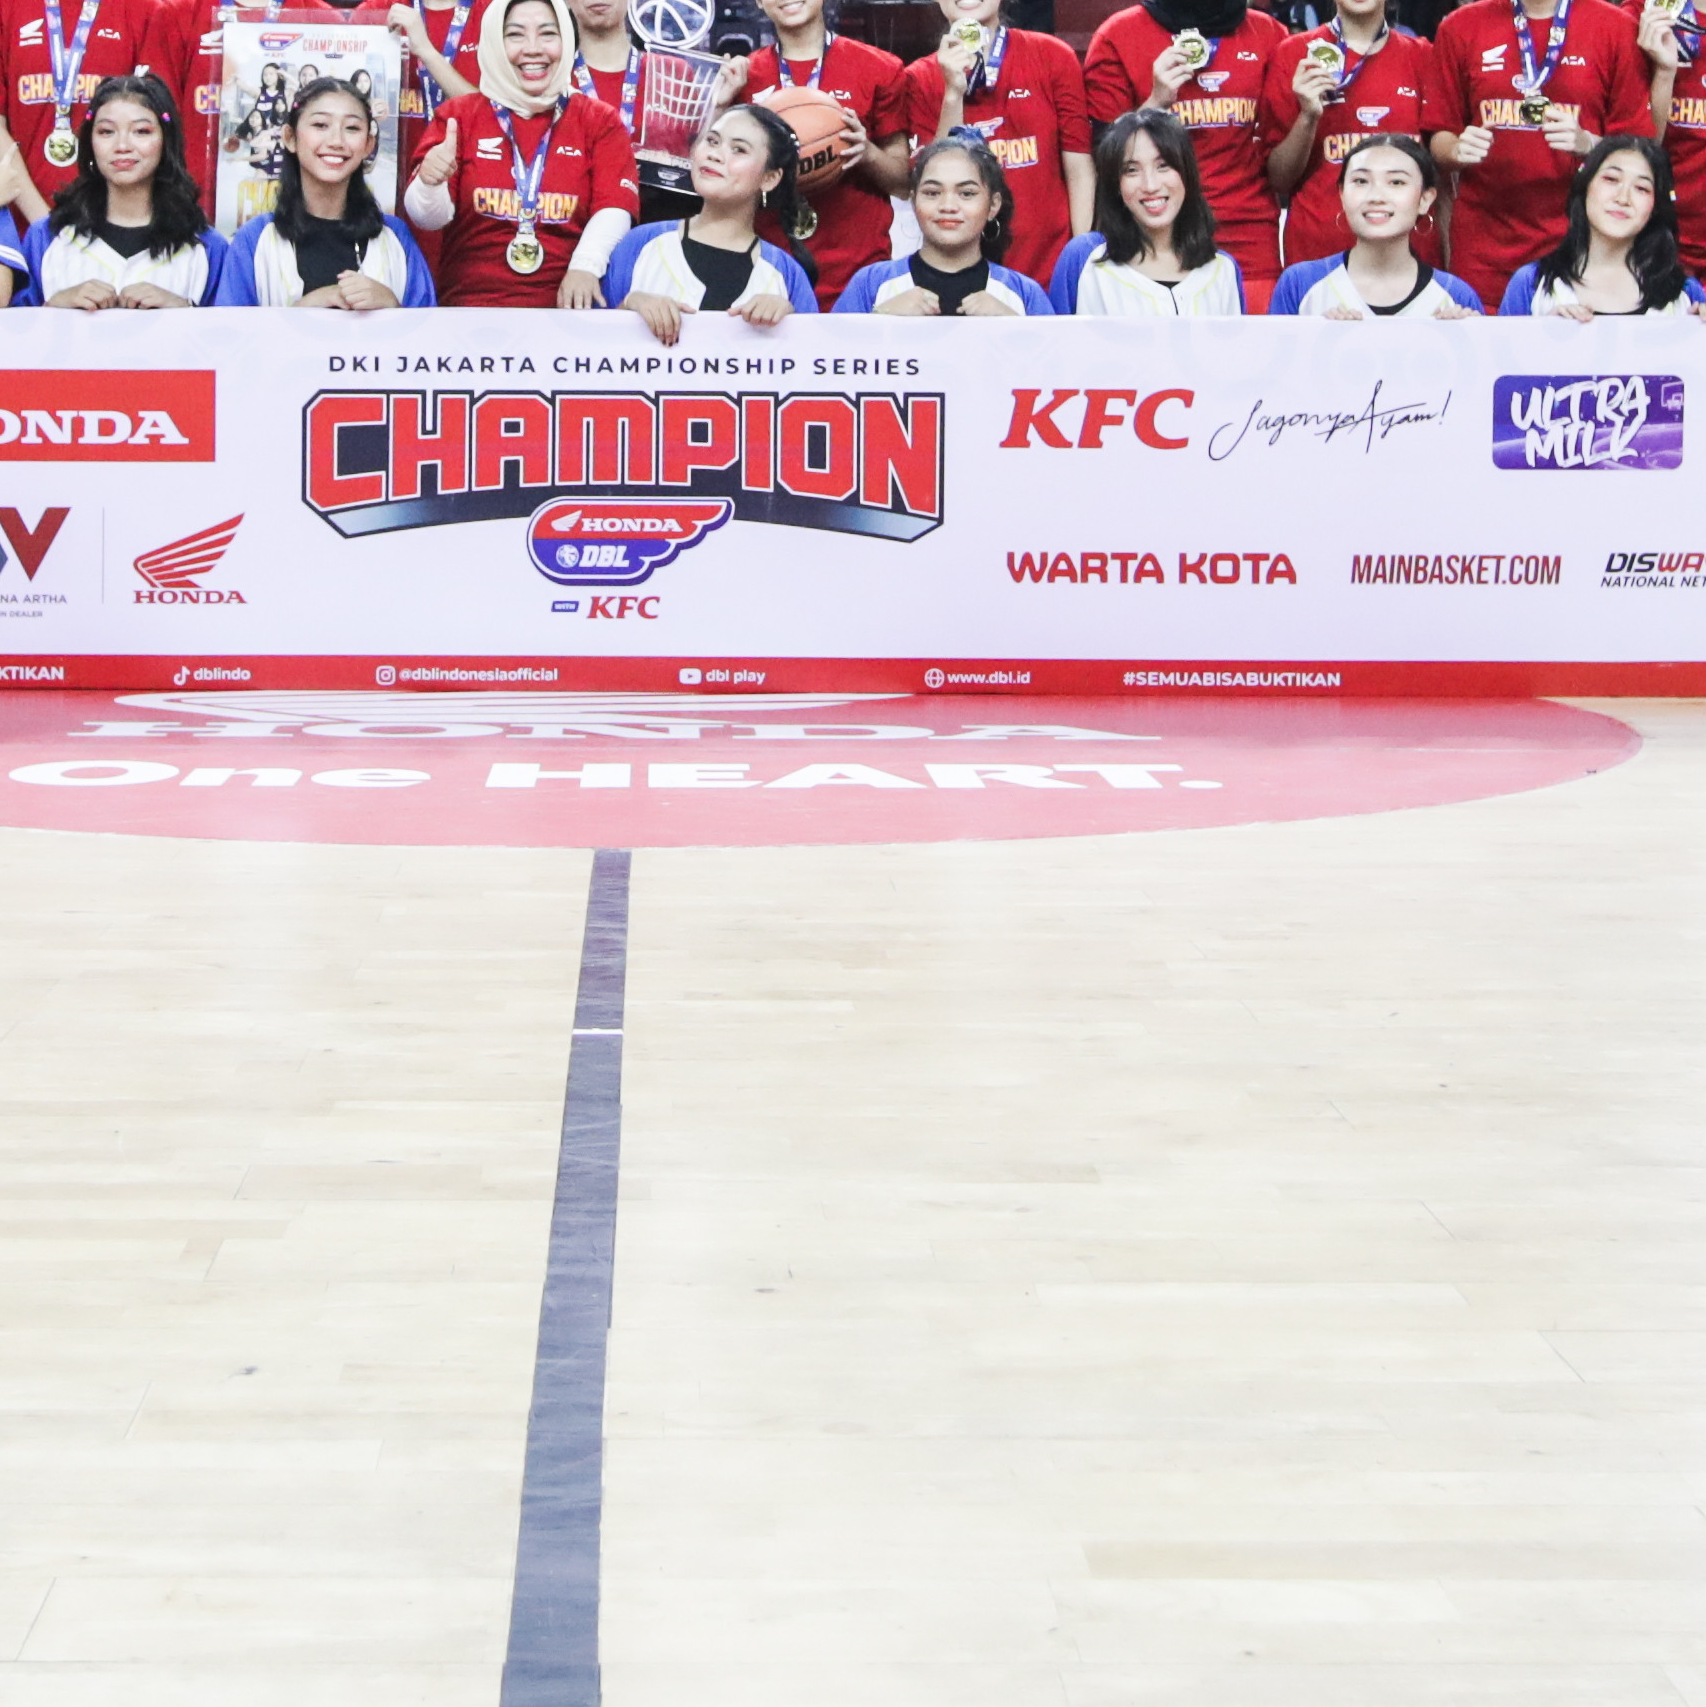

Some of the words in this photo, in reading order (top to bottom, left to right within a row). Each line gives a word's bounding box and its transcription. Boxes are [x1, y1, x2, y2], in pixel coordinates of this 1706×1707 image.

[799, 146, 838, 175] DBL
[329, 356, 381, 373] DKI
[396, 356, 536, 374] JAKARTA
[552, 356, 797, 375] CHAMPIONSHIP
[813, 358, 920, 376] SERIES
[1511, 375, 1651, 432] ULTRA
[999, 389, 1194, 449] KFC
[1525, 416, 1639, 468] MILK
[303, 389, 943, 526] CHAMPION
[581, 517, 683, 532] HONDA
[578, 545, 629, 567] DBL
[1007, 552, 1164, 584] WARTA
[1179, 553, 1297, 585] KOTA
[1351, 555, 1561, 585] MAINBASKET.COM
[1601, 576, 1675, 587] NATIONAL
[23, 594, 67, 604] ARTHA
[133, 591, 247, 604] HONDA
[586, 596, 660, 619] KFC
[194, 667, 251, 681] dblindo
[399, 667, 558, 684] @dblindonesiaofficial
[706, 669, 729, 682] dbl
[733, 669, 766, 686] play
[947, 670, 1031, 685] www.dbl.id
[1123, 672, 1341, 687] #SEMUABISABUKTIKAN
[68, 722, 1161, 740] HONDA
[7, 759, 431, 787] One
[485, 763, 1223, 790] HEART.
